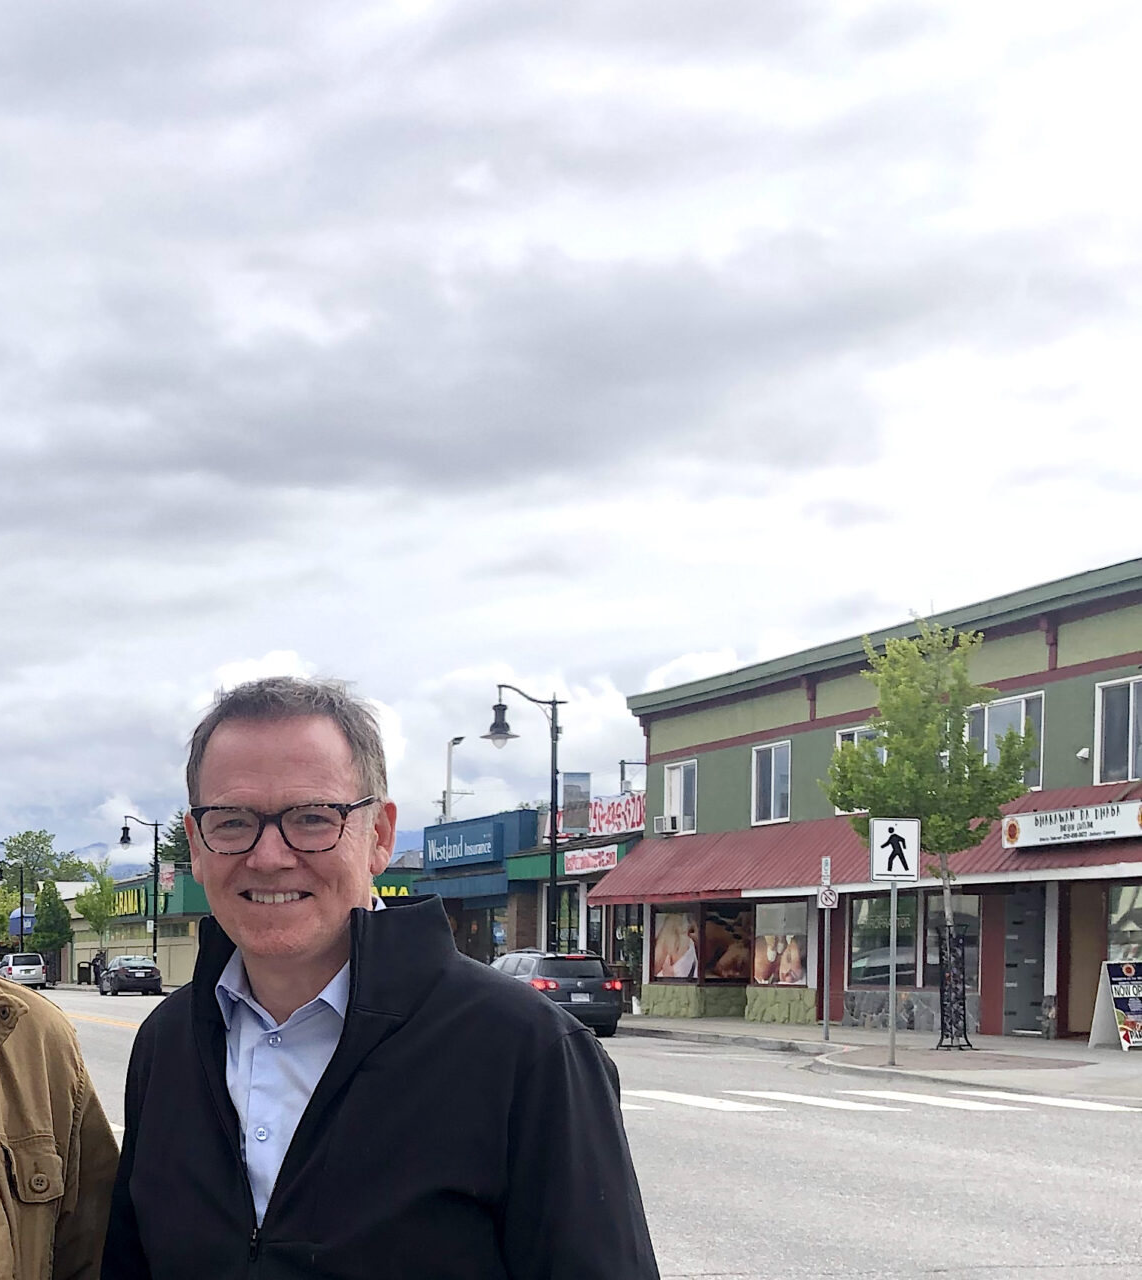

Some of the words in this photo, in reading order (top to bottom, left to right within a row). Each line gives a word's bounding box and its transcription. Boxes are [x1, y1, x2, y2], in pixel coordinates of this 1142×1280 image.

[427, 834, 463, 863] Westland
[464, 841, 492, 856] Insurance
[1114, 985, 1131, 997] NOW
